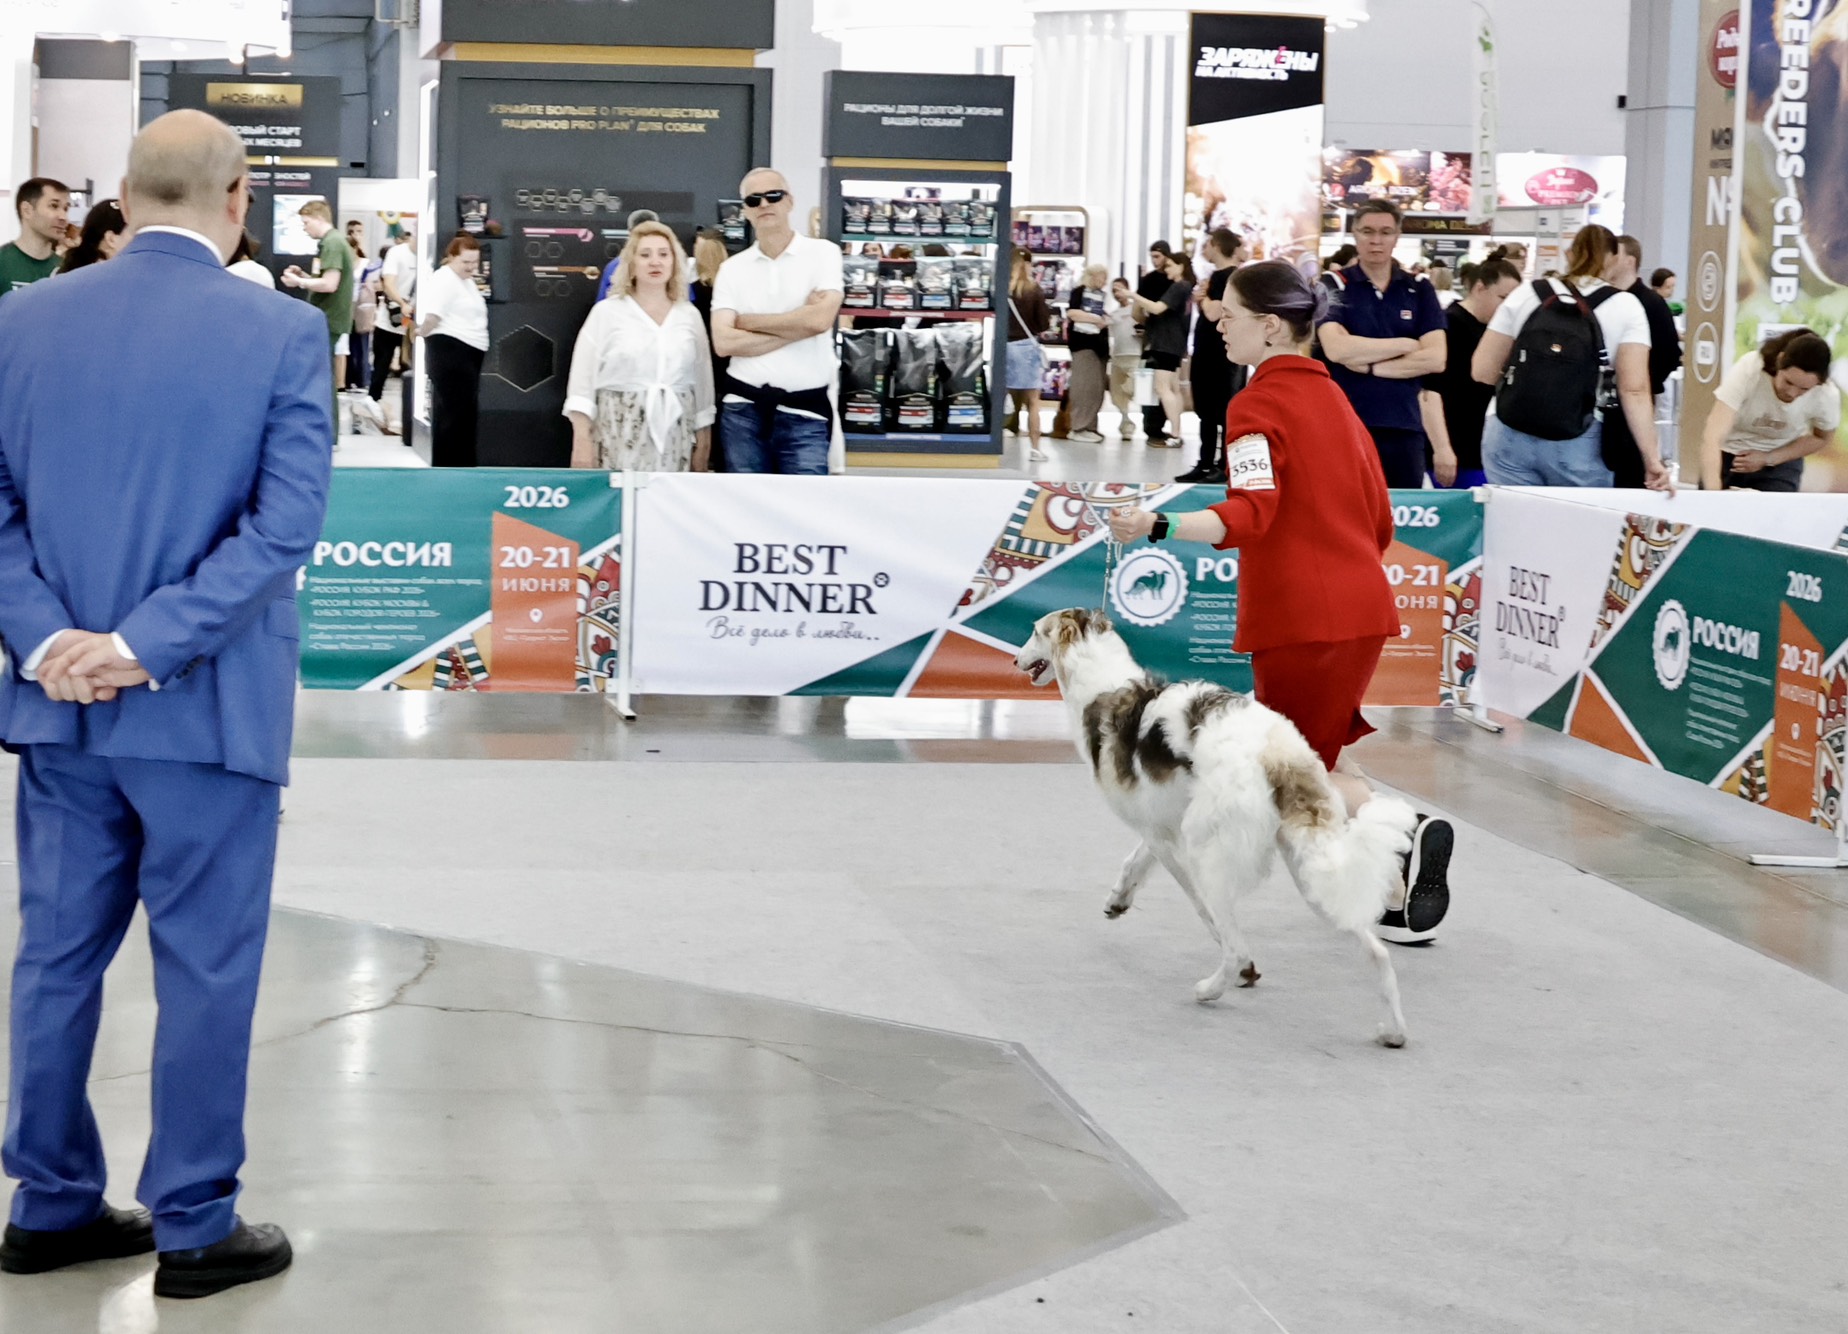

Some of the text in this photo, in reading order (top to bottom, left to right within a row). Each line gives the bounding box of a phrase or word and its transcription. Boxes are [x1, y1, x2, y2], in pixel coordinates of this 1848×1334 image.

[221, 93, 288, 104] НОВИНКА
[489, 102, 720, 119] УЗНАЙТЕ БОЛЬШЕ О ПРЕИМУЩЕСТВАХ
[896, 104, 919, 115] ДЛЯ
[267, 126, 302, 136] СТАРТ
[502, 118, 570, 130] РАЦИОНОВ
[571, 119, 597, 131] PRO
[637, 121, 663, 132] ДЛЯ
[664, 121, 706, 133] СОБАК
[1770, 196, 1804, 304] CLUB
[503, 485, 570, 508] 2026
[1390, 505, 1441, 528] 026
[312, 541, 452, 567] РОССИЯ
[499, 545, 570, 568] 20-21
[733, 542, 848, 576] BEST
[502, 577, 571, 592] ИЮНЯ
[1509, 566, 1551, 605] BEST
[1786, 570, 1823, 603] 2026
[698, 580, 879, 615] DINNER
[1496, 601, 1560, 649] DINNER
[1692, 615, 1761, 660] РОССИЯ
[1780, 643, 1820, 677] 20-21
